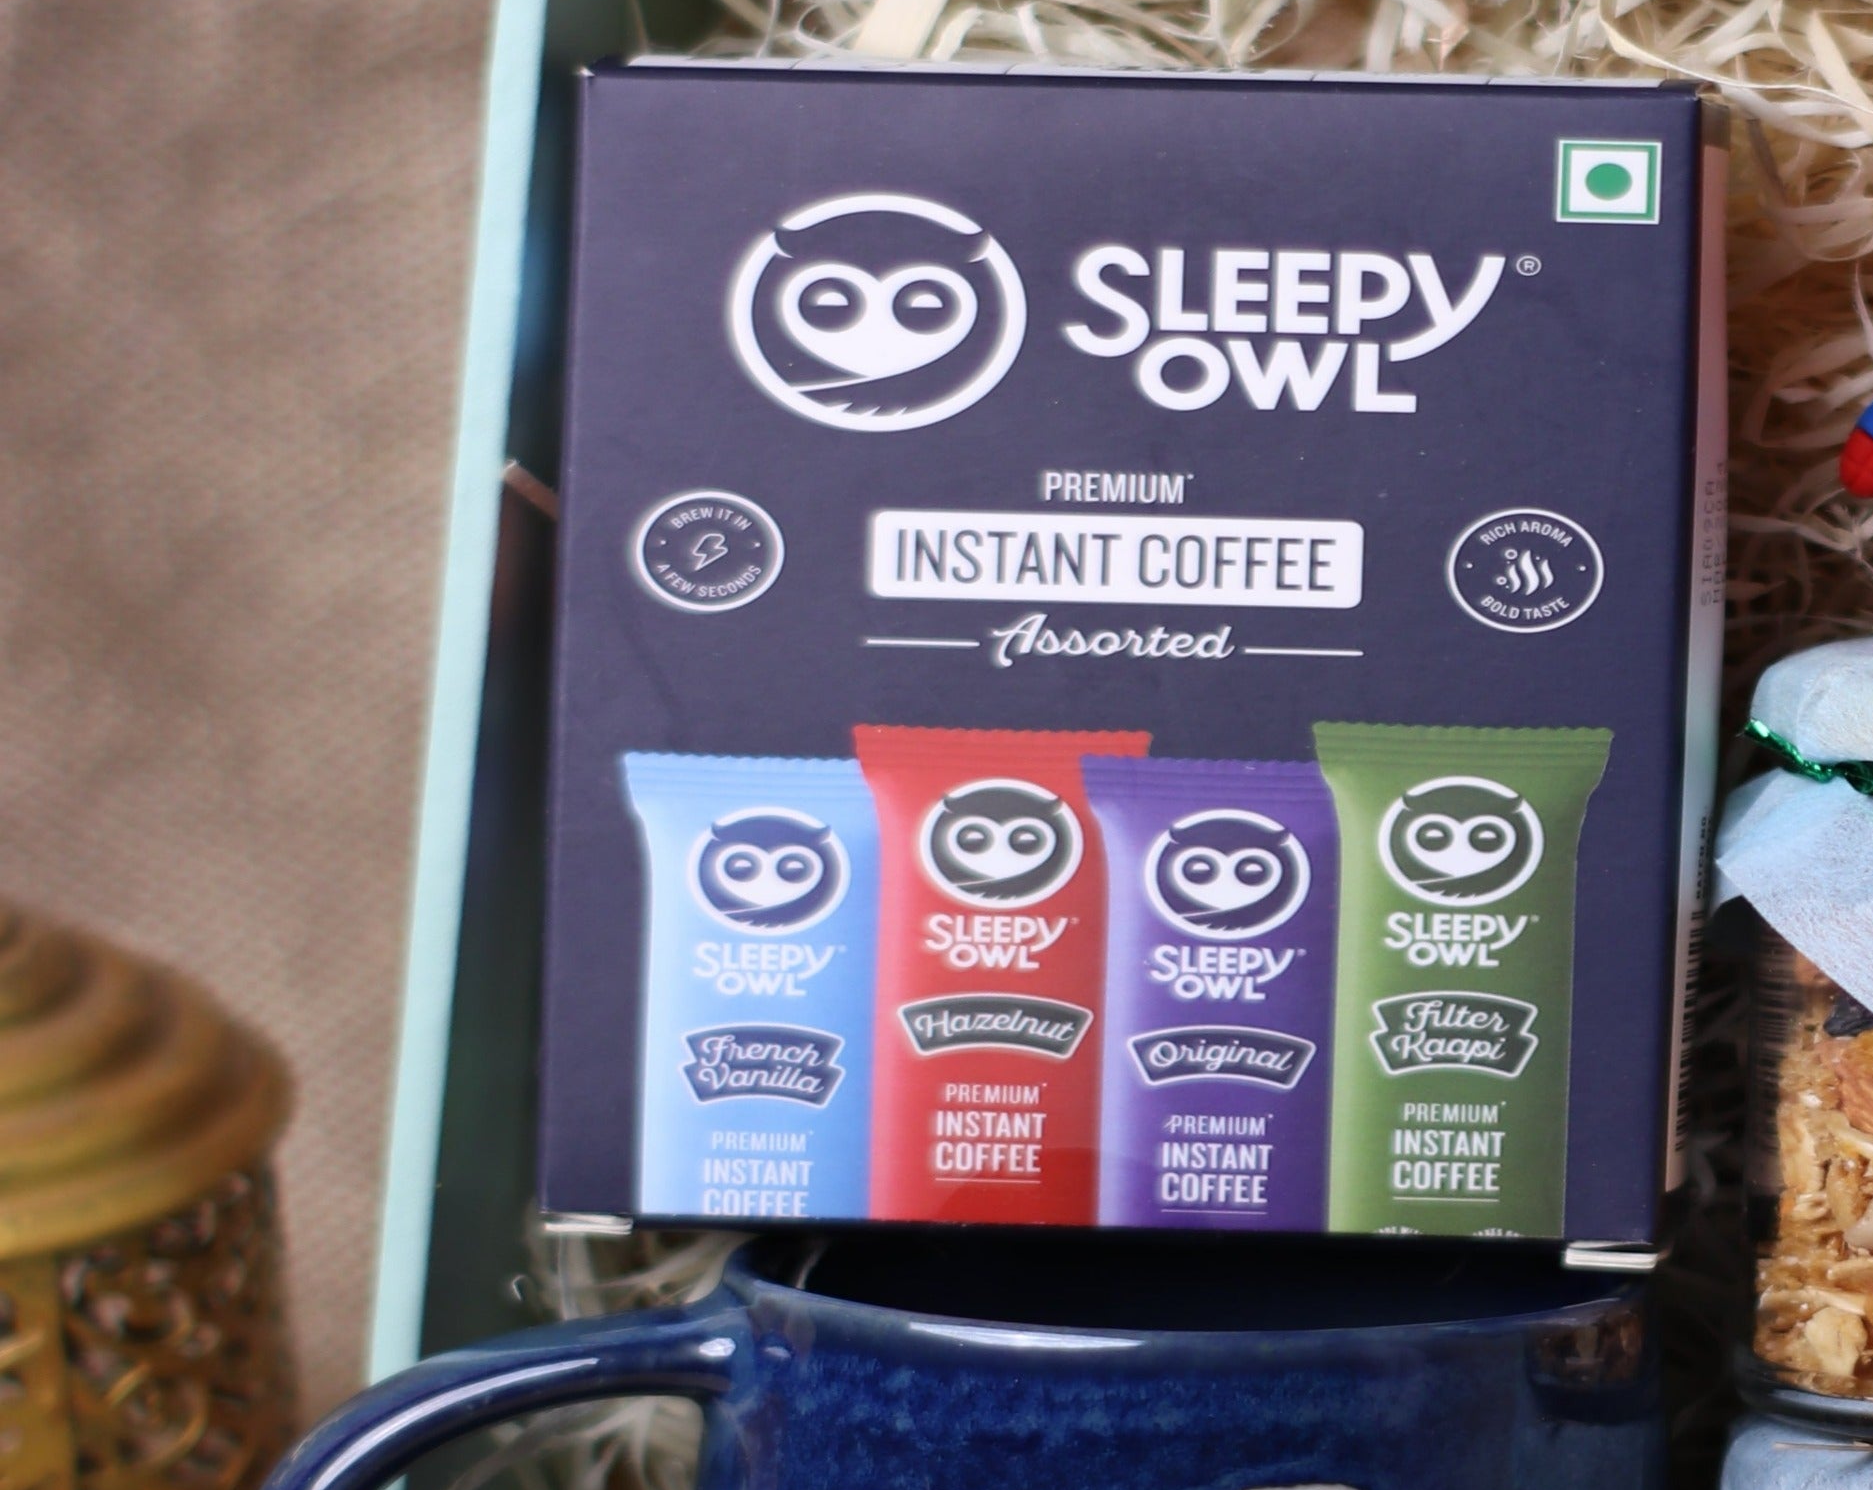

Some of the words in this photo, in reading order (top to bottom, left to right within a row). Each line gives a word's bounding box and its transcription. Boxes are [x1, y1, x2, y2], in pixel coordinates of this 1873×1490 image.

[1064, 245, 1506, 363] SLEEPY
[1138, 337, 1418, 414] OWL
[1043, 472, 1186, 504] PREMIUM
[670, 507, 714, 530] BREW
[718, 508, 734, 521] IT
[733, 515, 753, 531] IN
[1479, 522, 1517, 546] RICH
[1520, 521, 1574, 548] AROMA
[895, 528, 1122, 588] INSTANT
[1137, 534, 1337, 592] COFFEE
[657, 563, 671, 573] A
[664, 572, 697, 595] FEW
[697, 564, 762, 598] SECONDS
[1480, 595, 1520, 619] BOLD
[1523, 597, 1570, 620] TASTE
[992, 612, 1236, 668] Assorted
[925, 914, 1068, 953] SLEEPY
[1384, 912, 1528, 950] SLEEPY
[694, 941, 836, 980] SLEEPY
[949, 944, 1040, 970] OWL
[1151, 945, 1295, 984] SLEEPY
[1408, 941, 1500, 967] OWL
[717, 972, 807, 997] OWL
[1174, 974, 1266, 1000] OWL
[914, 1009, 1076, 1042] Hazelnut
[1404, 1000, 1510, 1033] Filter
[701, 1034, 824, 1068] French
[1149, 1039, 1295, 1072] Original
[1391, 1031, 1507, 1063] Kaapi
[699, 1062, 825, 1094] Vanilla
[945, 1083, 1040, 1104] PREMIUM
[936, 1110, 1047, 1139] INSTANT
[1403, 1103, 1499, 1124] PREMIUM
[712, 1130, 807, 1152] PREMIUM
[935, 1141, 1042, 1173] COFFEE
[1161, 1142, 1273, 1171] INSTANT
[1393, 1129, 1505, 1158] INSTANT
[704, 1158, 814, 1186] INSTANT
[1160, 1172, 1268, 1204] COFFEE
[1393, 1160, 1501, 1192] COFFEE
[704, 1188, 810, 1218] COFFEE
